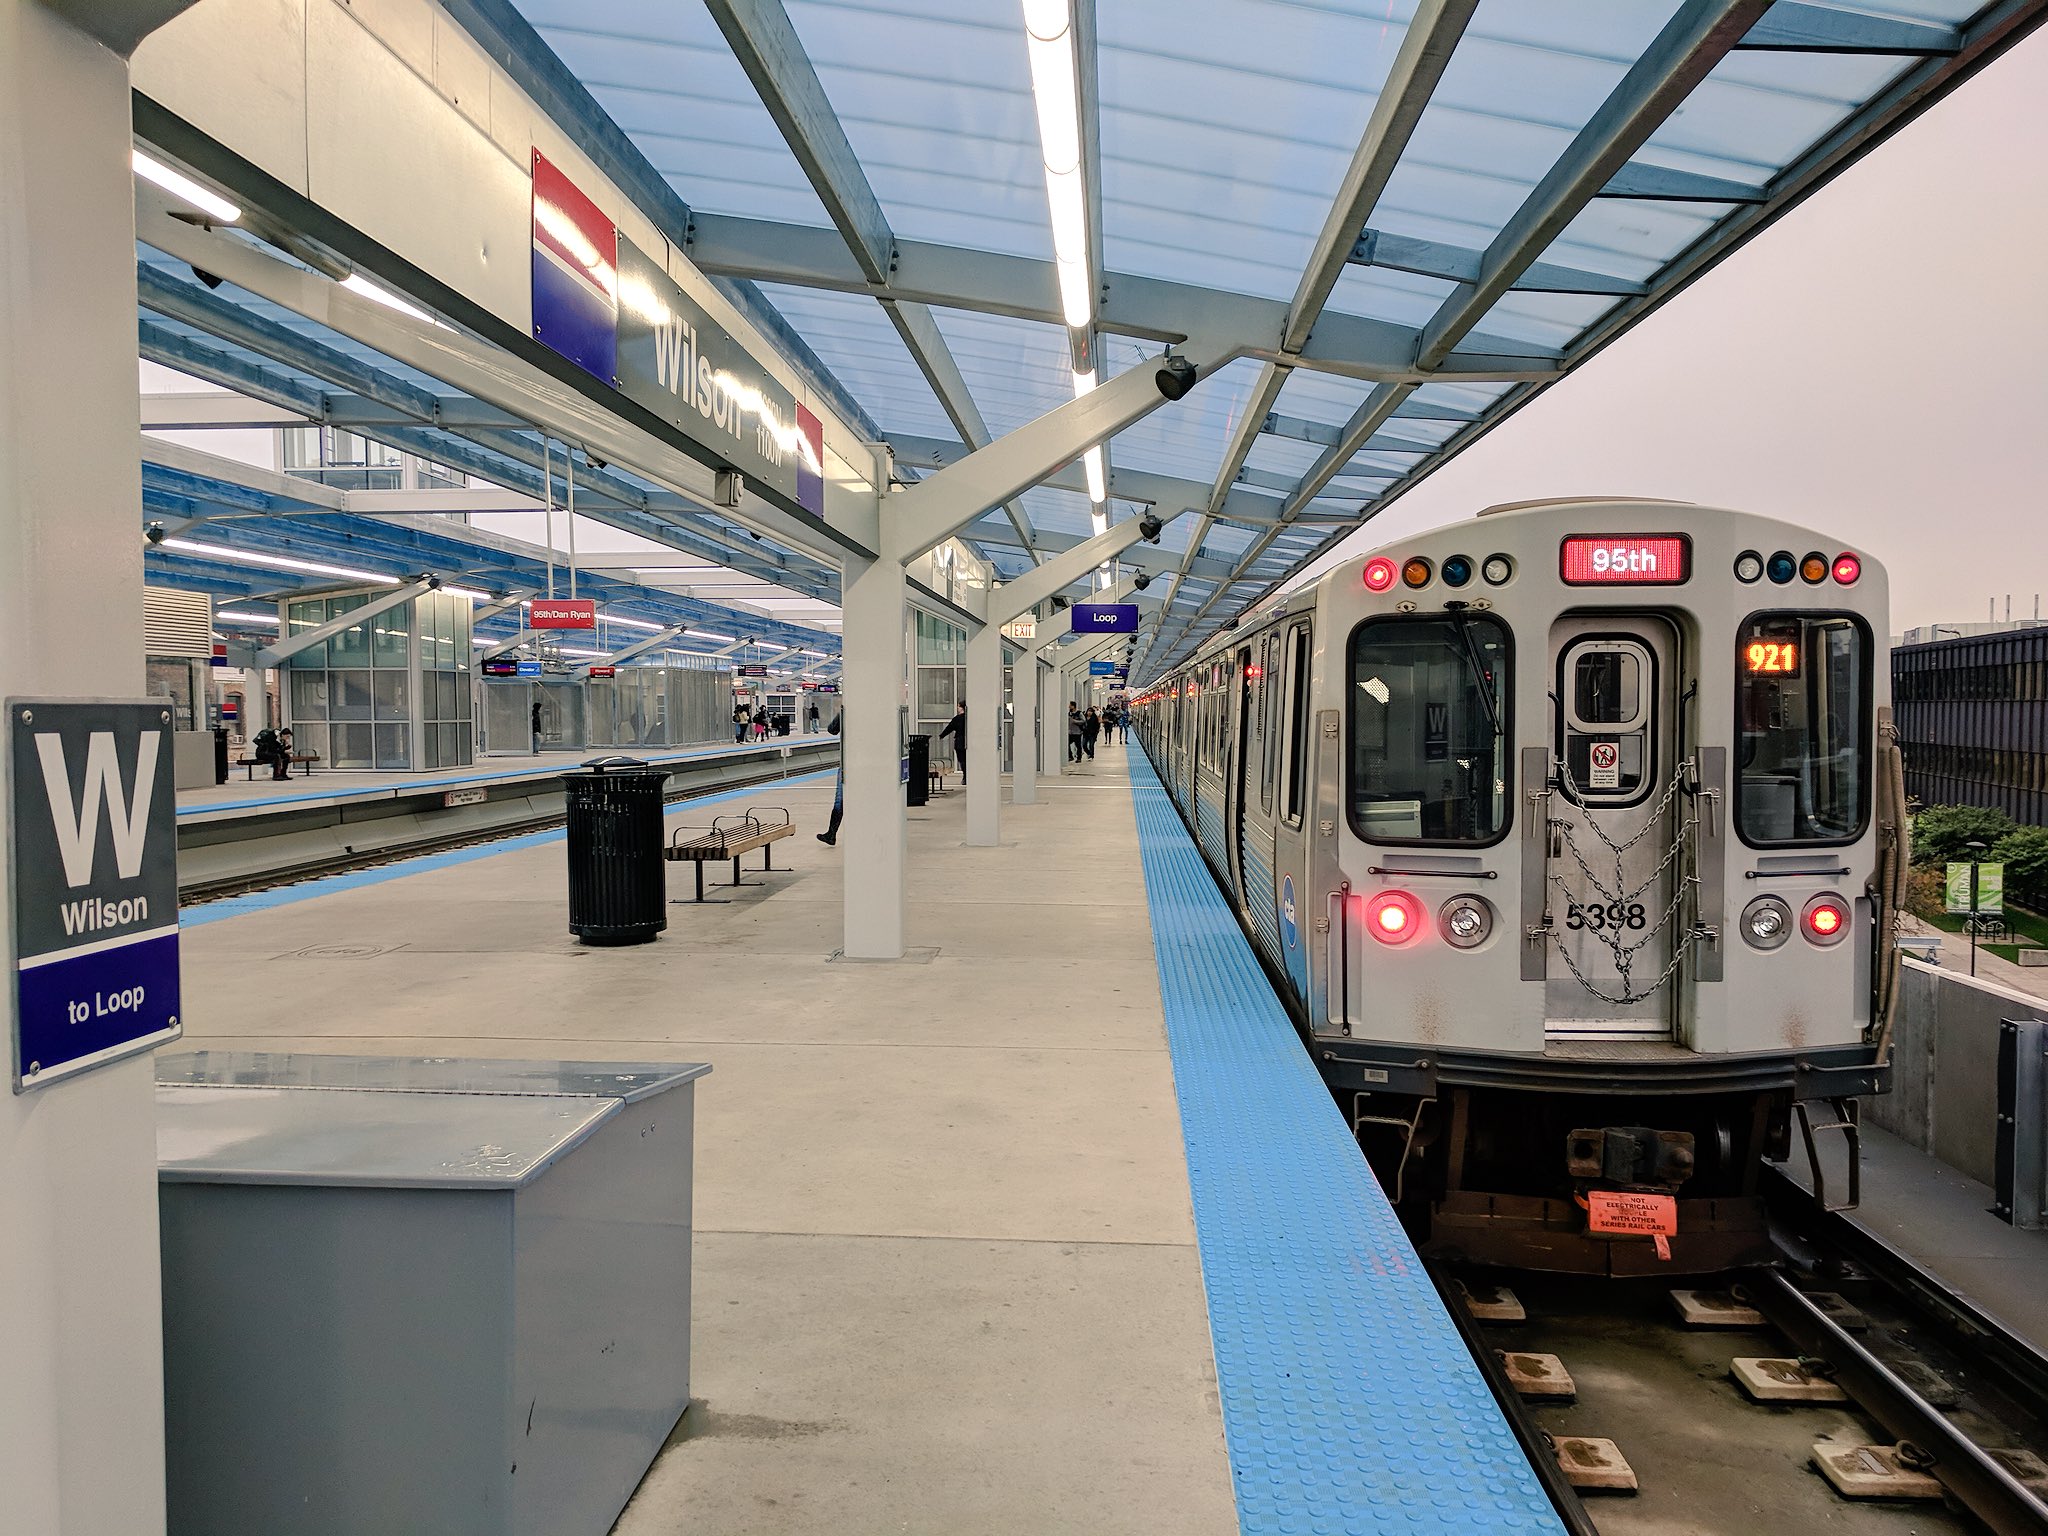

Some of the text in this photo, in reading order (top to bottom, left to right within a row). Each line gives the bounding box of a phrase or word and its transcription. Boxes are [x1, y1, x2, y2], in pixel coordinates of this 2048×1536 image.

[655, 314, 741, 440] Wilson
[1592, 548, 1656, 572] 95th
[533, 610, 591, 620] 95th/Dan Ryan
[1093, 613, 1117, 624] Loop
[1014, 624, 1032, 636] EXIT
[1749, 644, 1792, 671] 921
[34, 730, 161, 888] W
[1959, 865, 1971, 910] TRUMAN
[61, 896, 148, 935] Wilson
[1566, 903, 1646, 930] 5398
[68, 985, 145, 1024] to Loop
[1606, 1202, 1659, 1211] ELECTRICALLY
[1600, 1220, 1626, 1228] SERIES
[1631, 1216, 1656, 1224] OTHER
